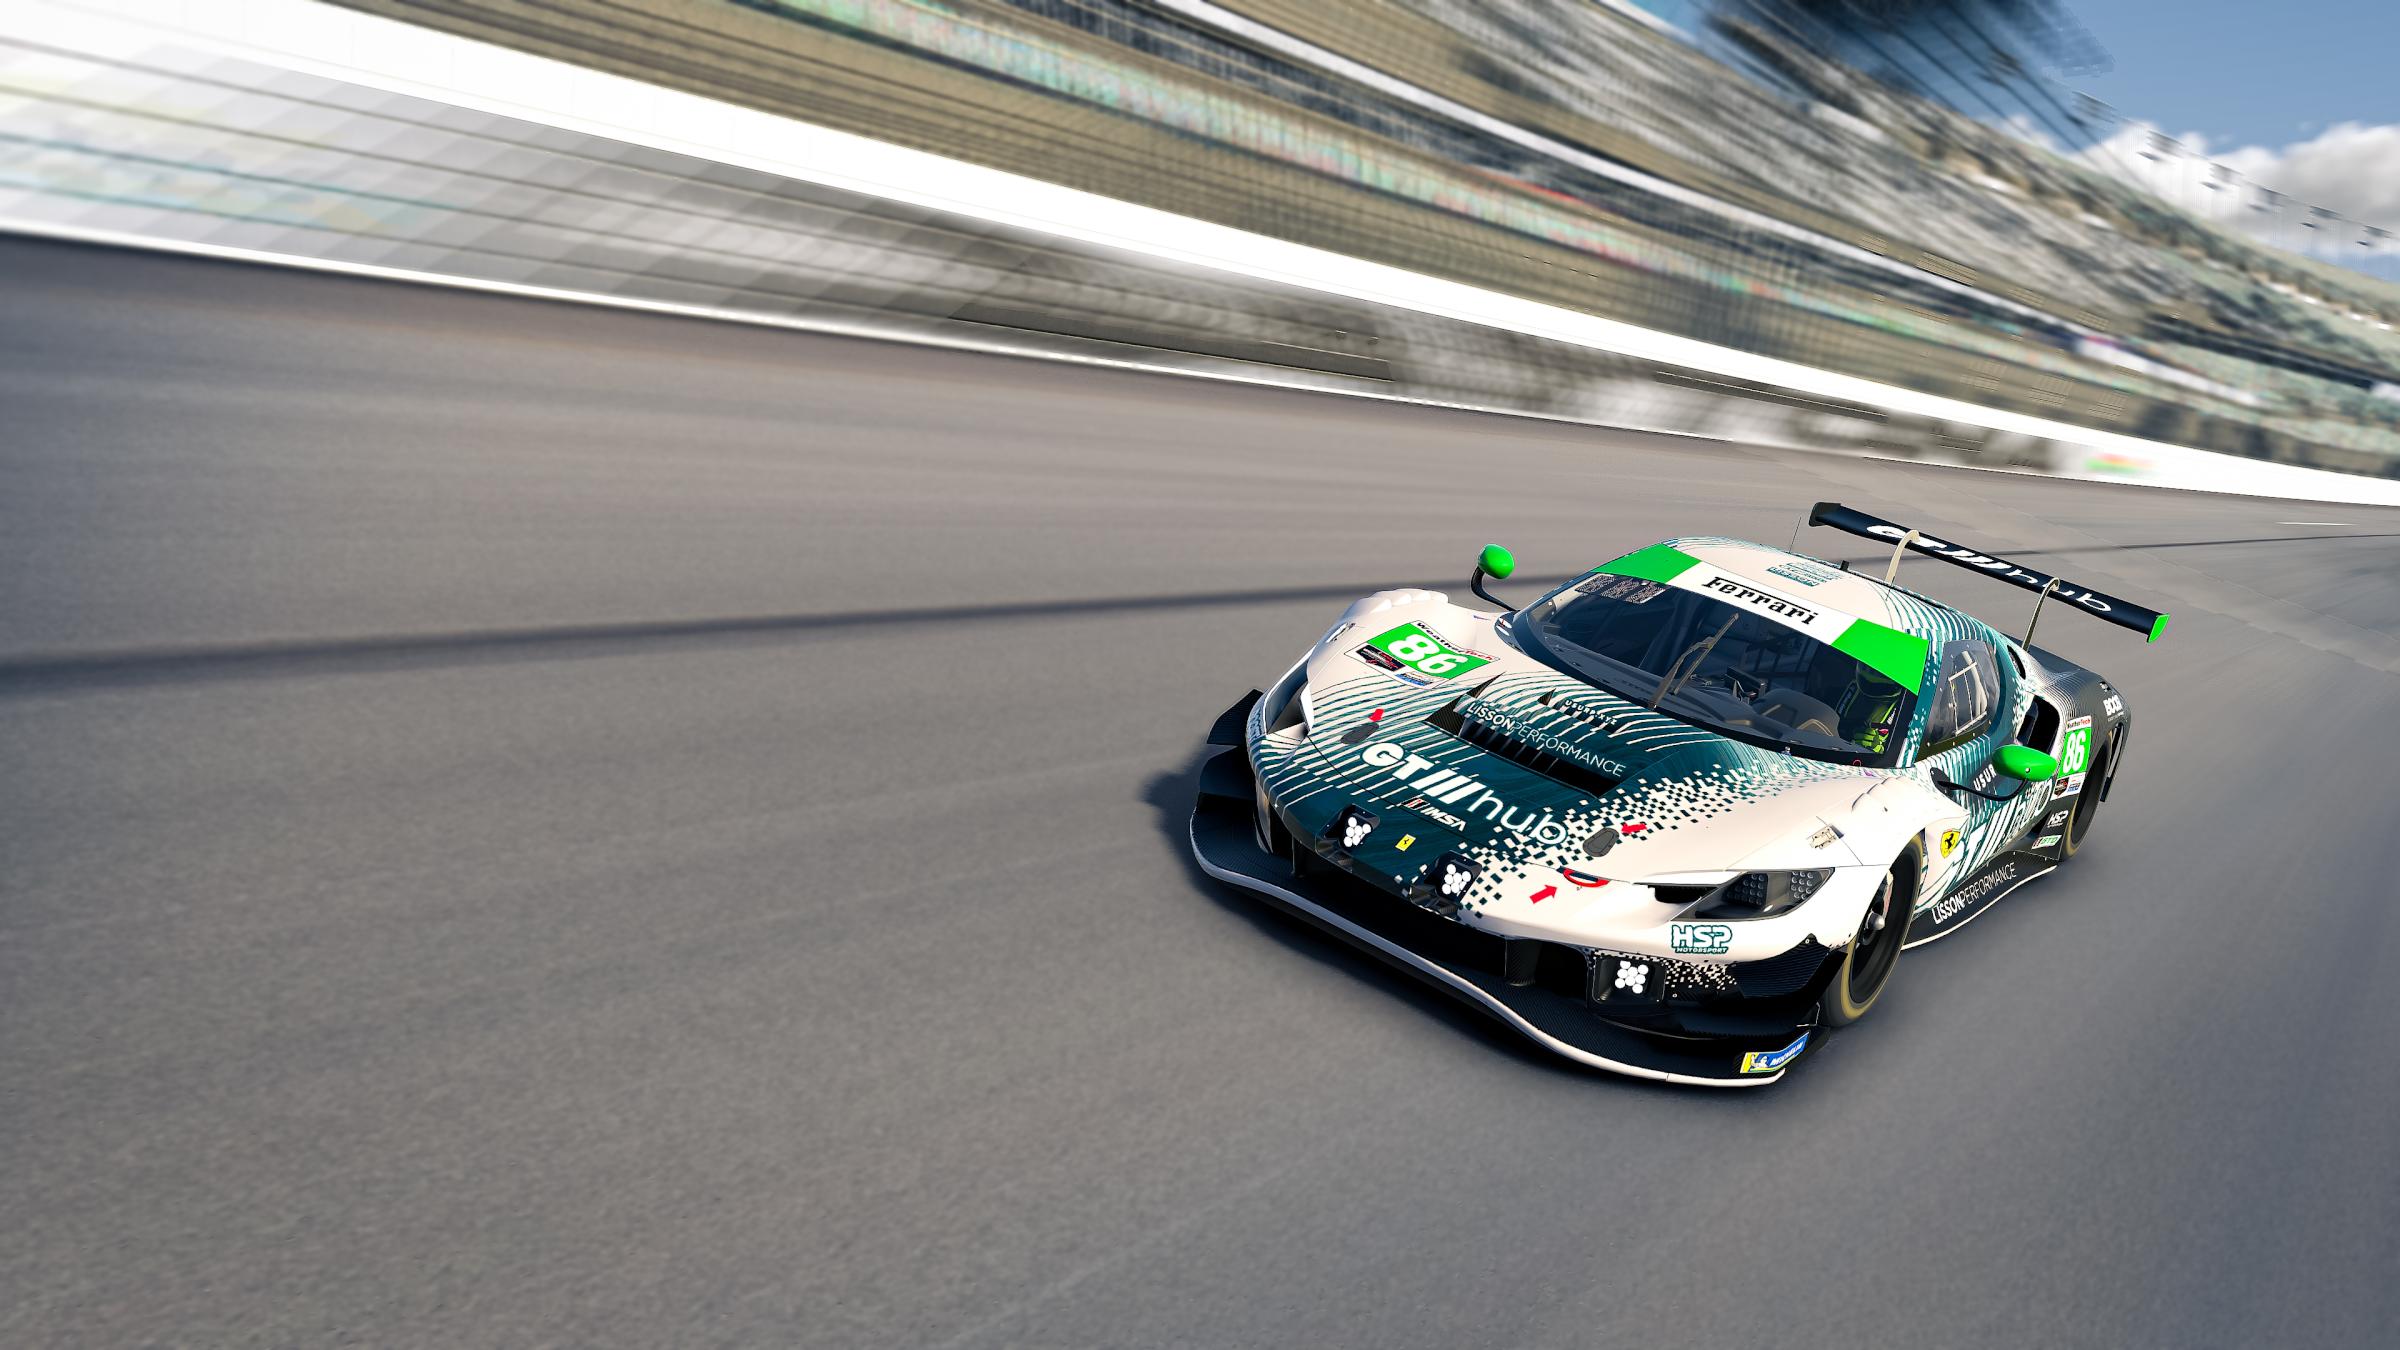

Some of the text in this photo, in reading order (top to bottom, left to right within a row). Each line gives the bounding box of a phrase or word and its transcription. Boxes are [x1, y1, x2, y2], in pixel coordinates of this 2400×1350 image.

[1702, 576, 1819, 625] Ferrari
[1387, 633, 1469, 674] 86
[2062, 730, 2087, 774] 86
[1419, 806, 1467, 832] IMSA
[1670, 925, 1733, 949] HSP
